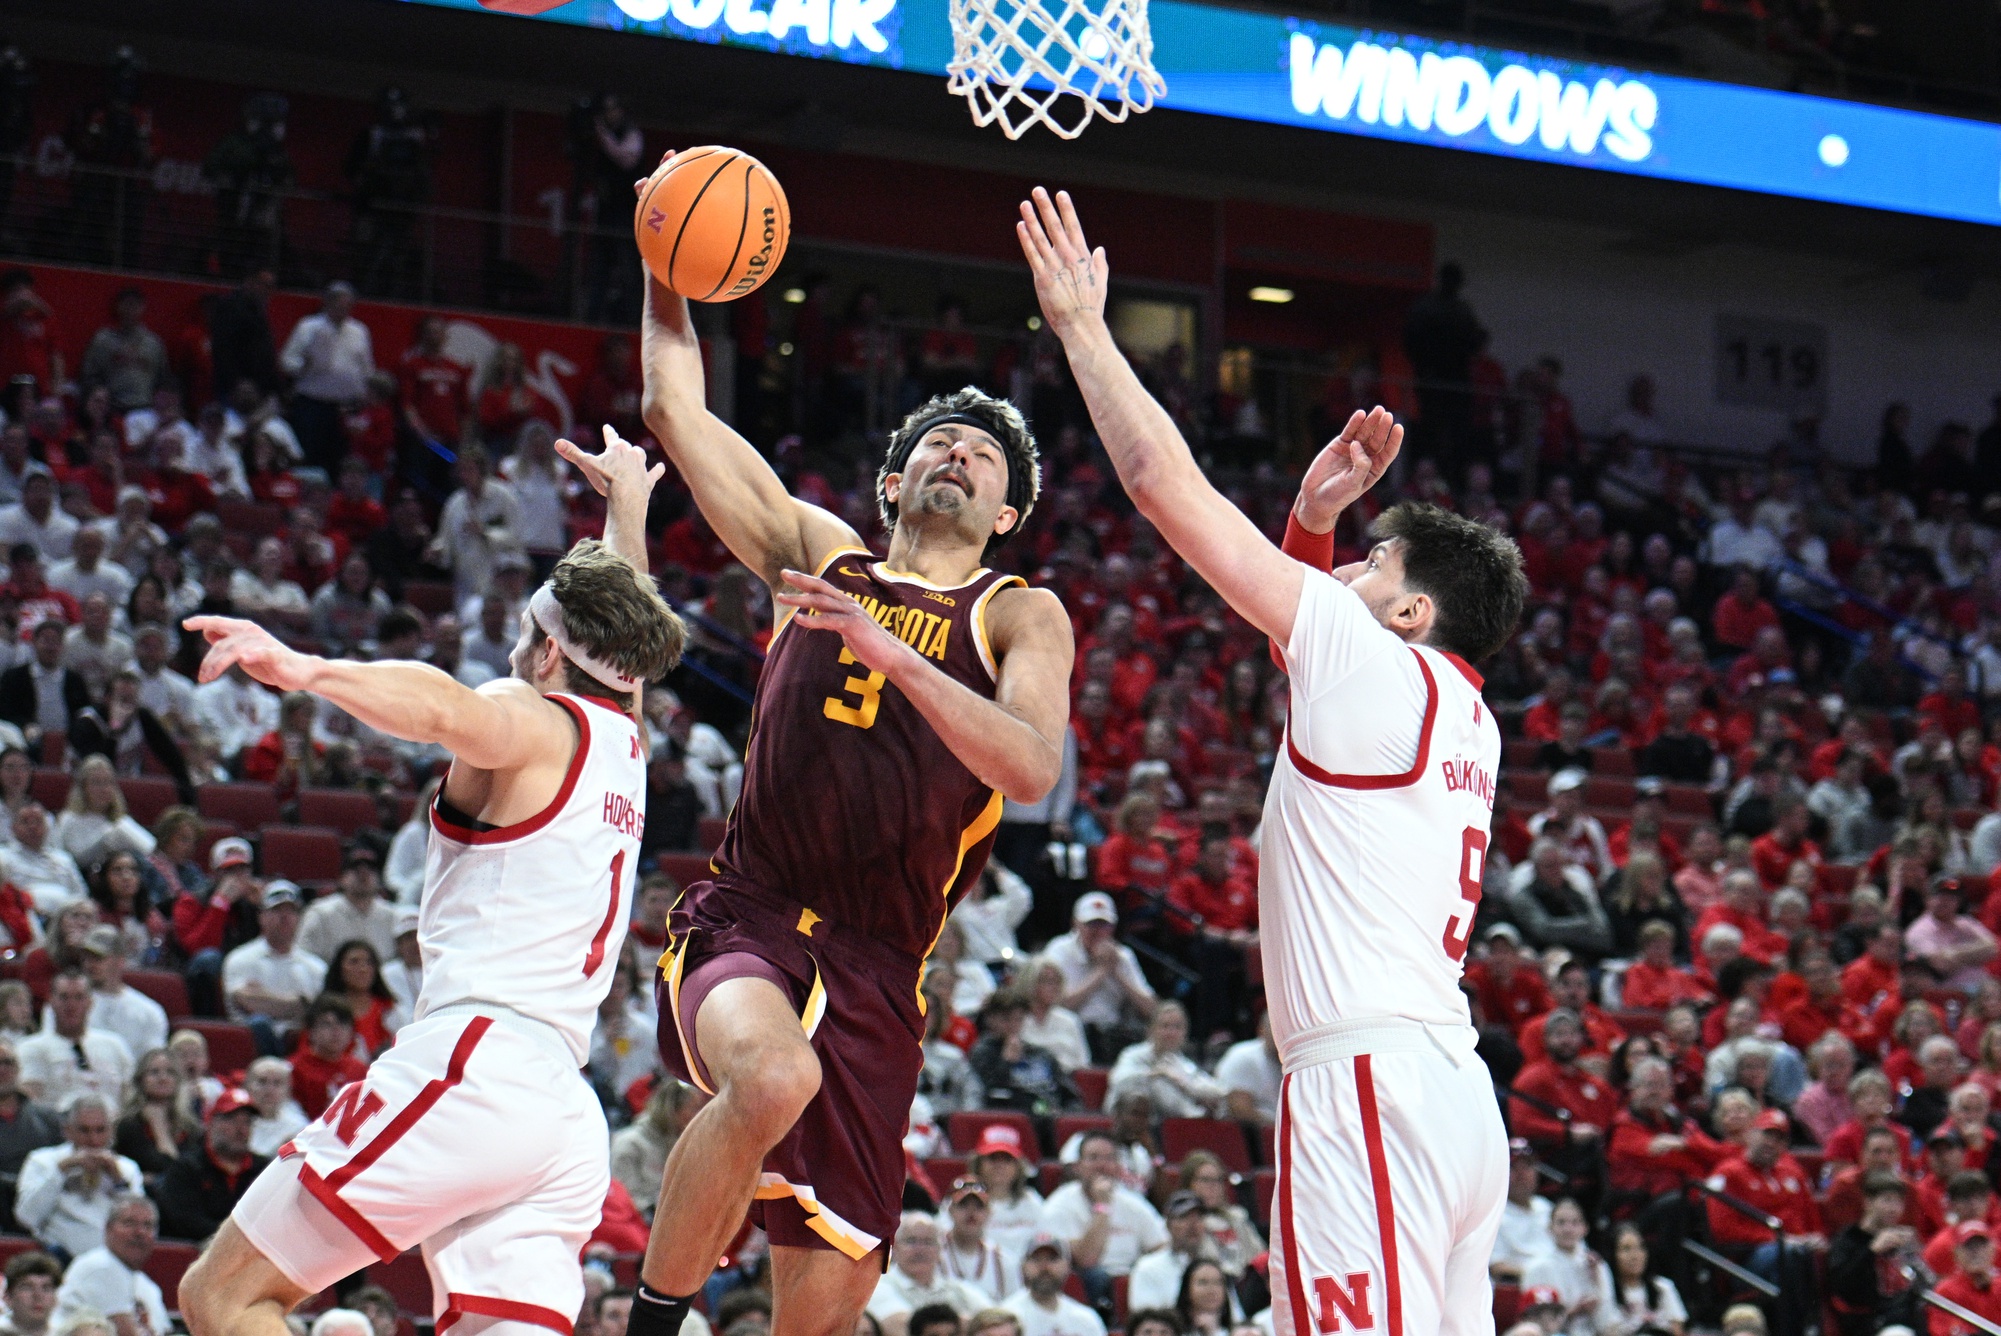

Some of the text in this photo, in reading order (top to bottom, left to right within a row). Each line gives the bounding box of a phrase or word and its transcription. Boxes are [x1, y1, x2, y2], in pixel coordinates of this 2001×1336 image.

[1290, 31, 1658, 162] WINDOWS
[724, 206, 776, 297] Wilson
[1727, 337, 1820, 391] 119
[823, 647, 887, 730] 3
[582, 848, 626, 981] 1
[1442, 825, 1488, 963] 9
[321, 1080, 389, 1150] N
[1312, 1270, 1376, 1336] N
